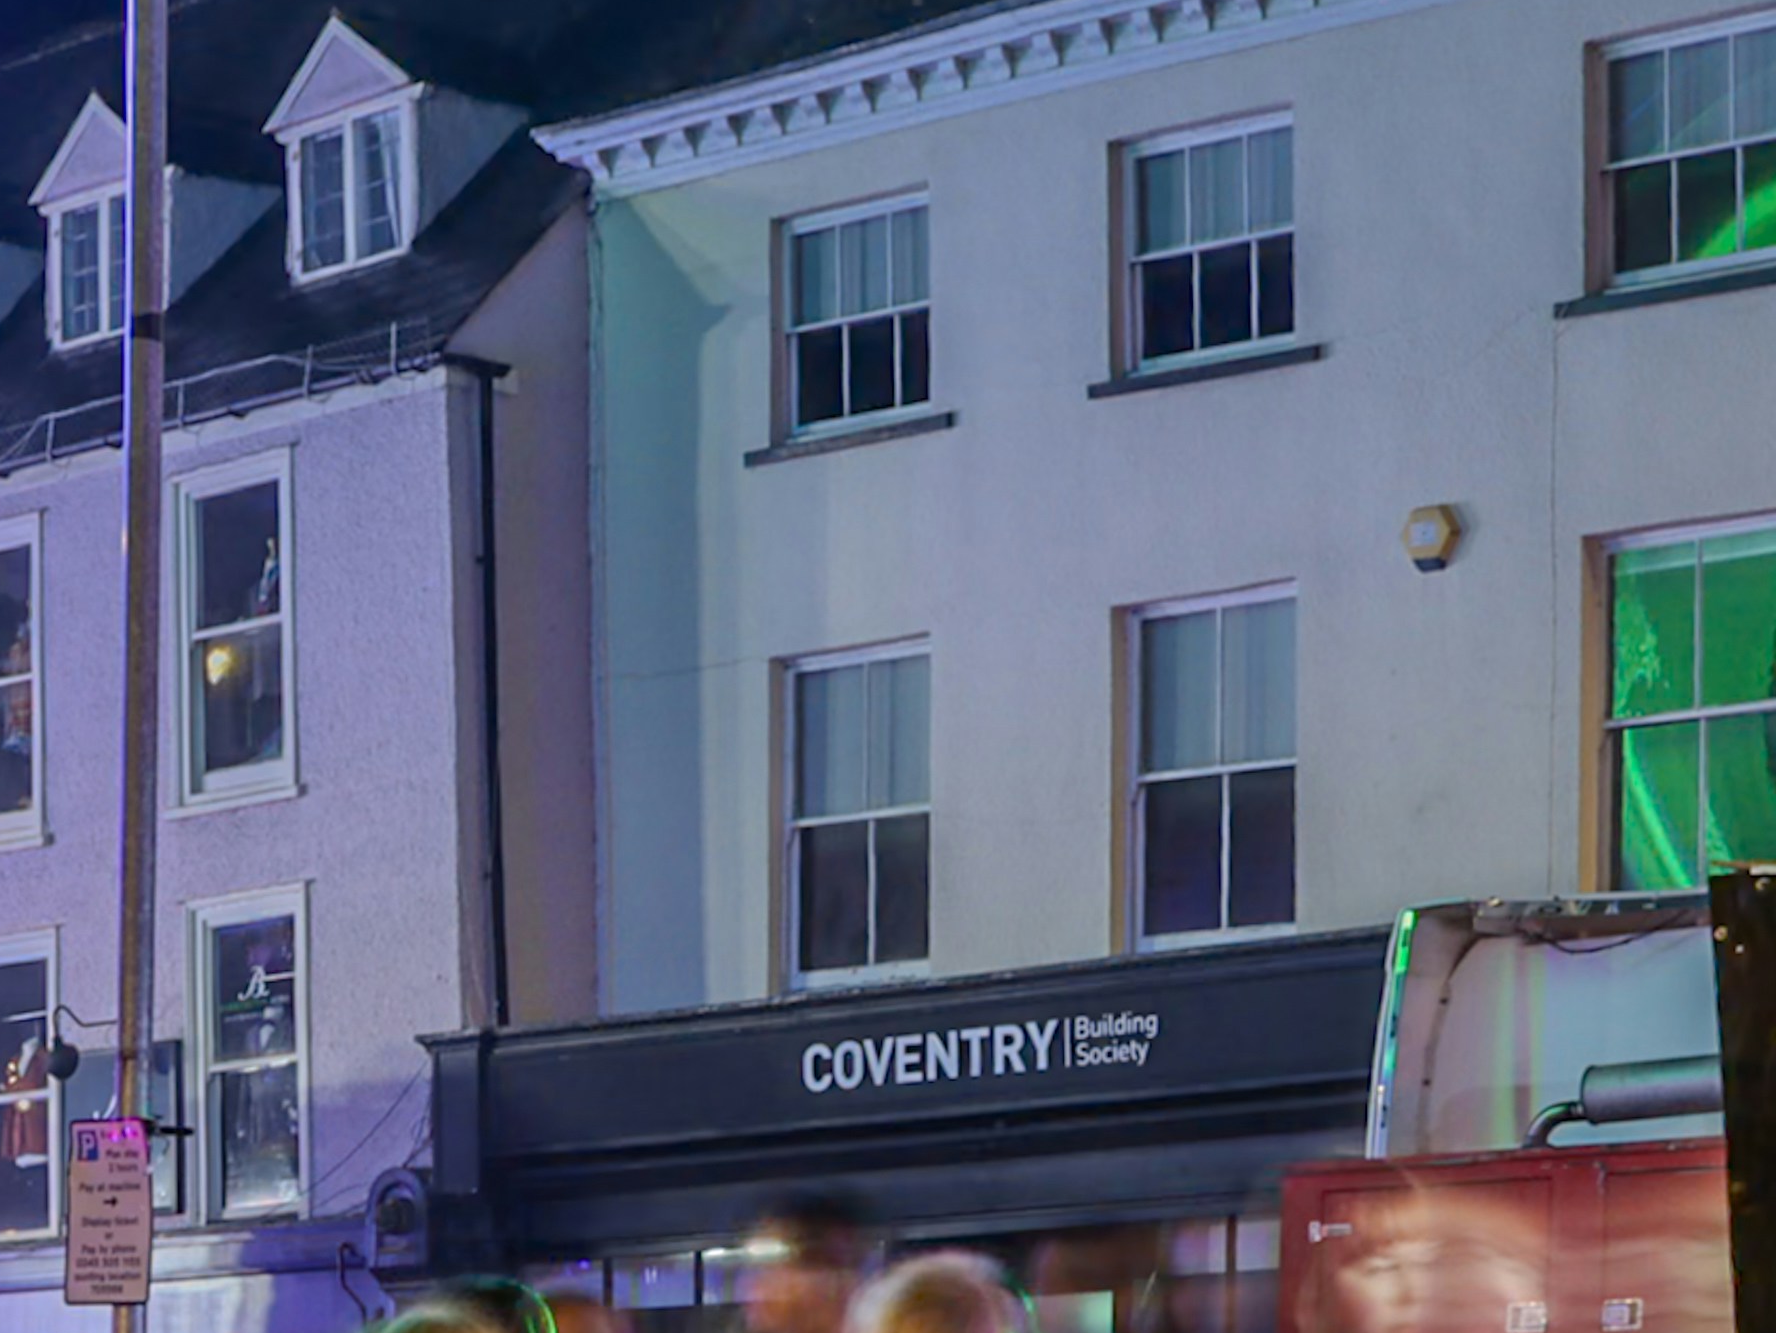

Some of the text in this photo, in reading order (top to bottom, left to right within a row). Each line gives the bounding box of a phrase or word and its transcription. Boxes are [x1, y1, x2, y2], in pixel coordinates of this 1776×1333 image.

[802, 1010, 1159, 1093] COVENTRY Building
[1075, 1038, 1150, 1067] Society
[79, 1181, 141, 1194] Pay at machine
[81, 1215, 139, 1228] Display ticket
[81, 1244, 96, 1255] Pay
[111, 1244, 138, 1255] phone
[108, 1269, 142, 1281] location
